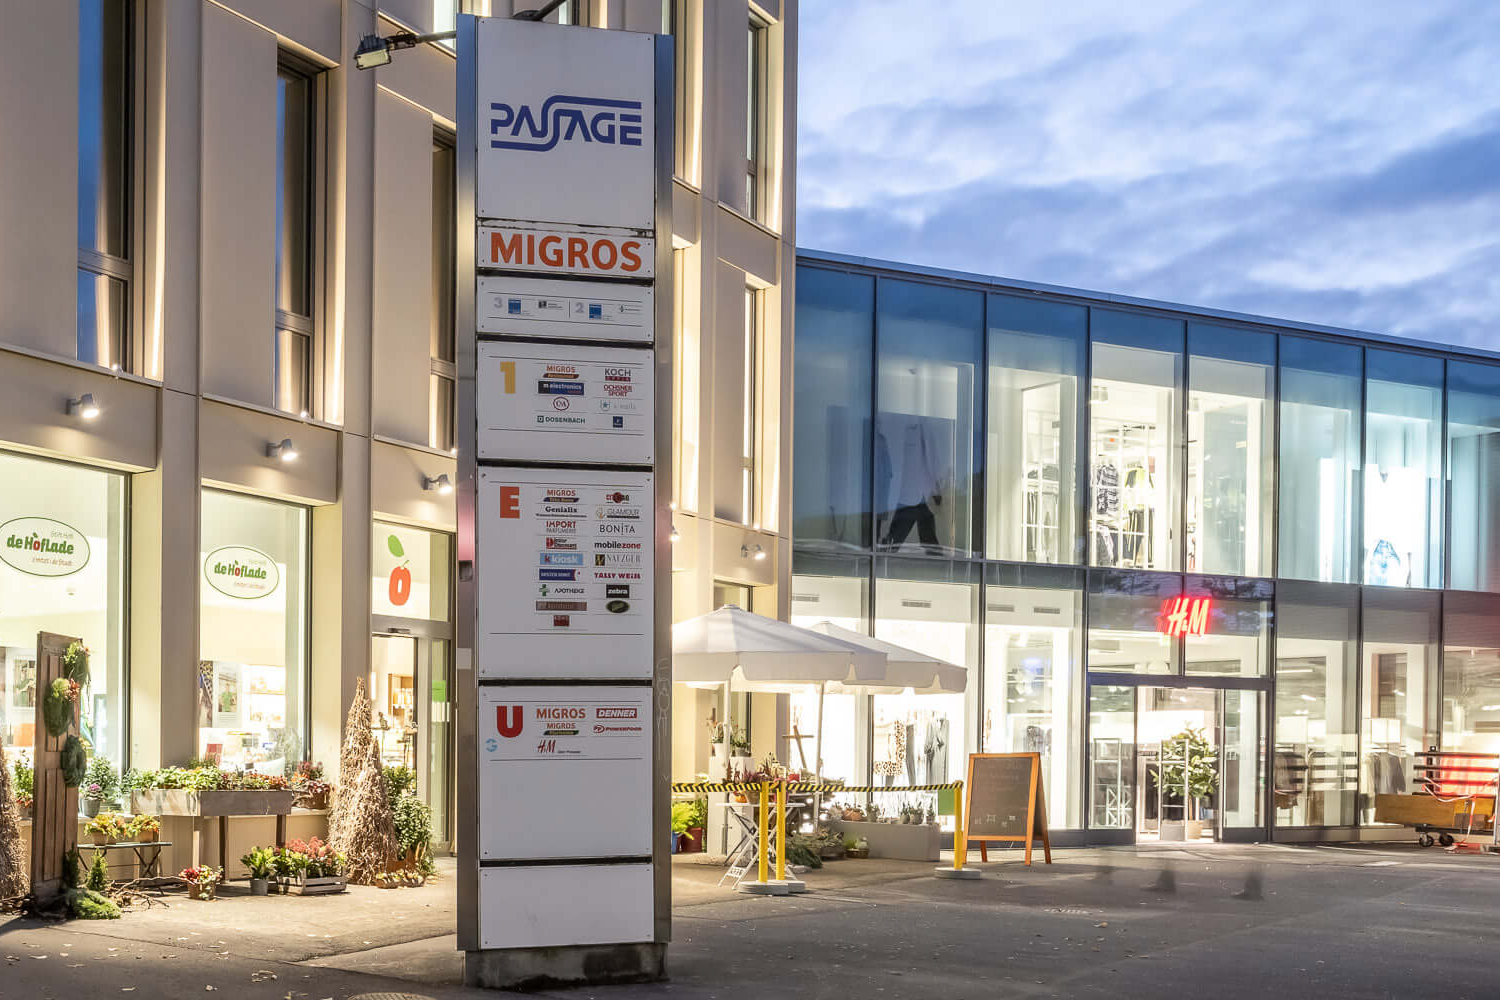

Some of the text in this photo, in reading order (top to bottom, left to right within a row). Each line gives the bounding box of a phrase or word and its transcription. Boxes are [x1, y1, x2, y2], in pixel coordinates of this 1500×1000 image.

[491, 95, 642, 152] PASSAGE
[491, 231, 642, 272] MIGROS
[575, 302, 585, 314] 2
[546, 365, 576, 373] MIGROS
[604, 368, 632, 377] KOCH
[500, 361, 516, 394] 1
[545, 416, 586, 424] DOSENBACH
[546, 489, 576, 497] MIGROS
[500, 486, 520, 519] E
[546, 520, 577, 528] IMPORT
[594, 541, 642, 549] mobilezone
[1167, 597, 1210, 637] H&M
[536, 708, 586, 719] MIGROS
[597, 709, 636, 718] DENNER
[496, 705, 524, 738] U
[546, 722, 576, 730] MIGROS
